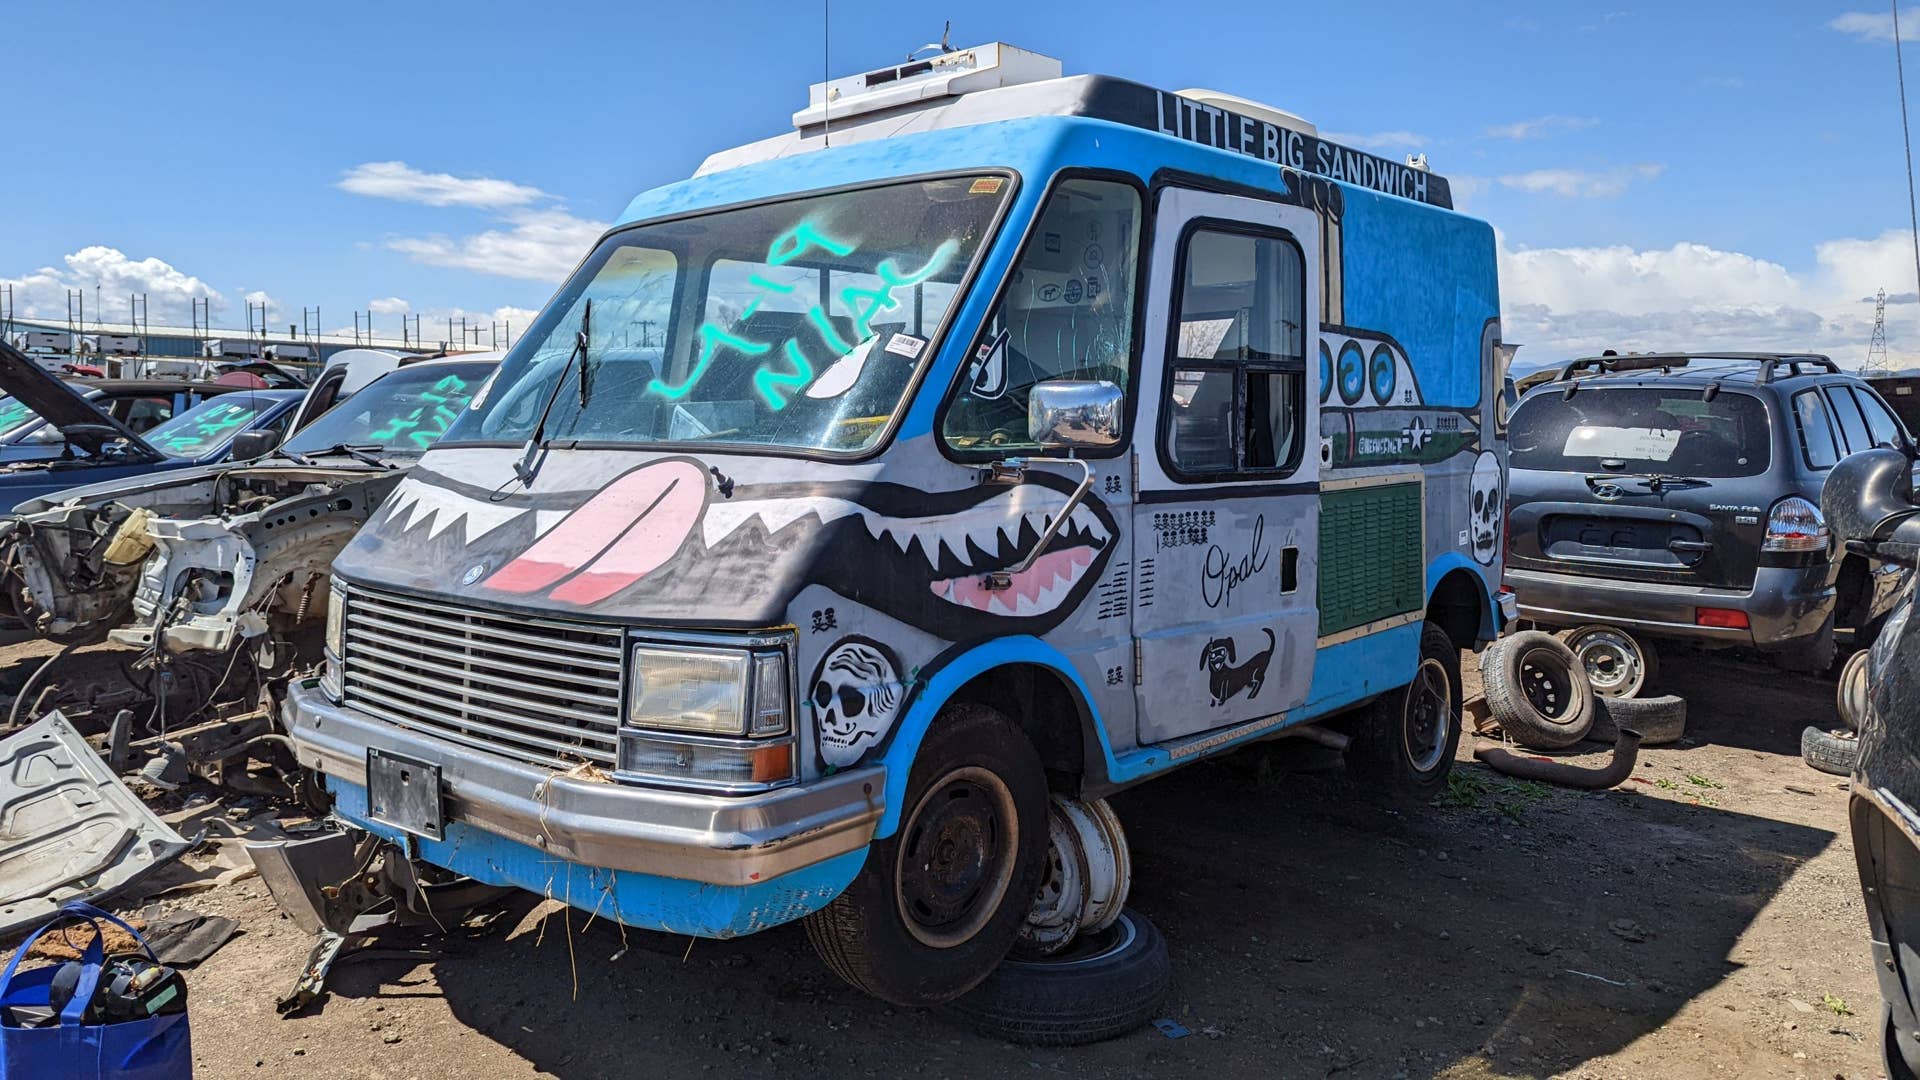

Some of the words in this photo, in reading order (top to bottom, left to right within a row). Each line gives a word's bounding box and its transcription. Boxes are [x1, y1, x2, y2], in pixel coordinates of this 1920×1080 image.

[1156, 91, 1255, 157] LITTLE
[1263, 123, 1304, 170] BIG
[1316, 142, 1428, 202] SANDWICH
[1709, 503, 1739, 512] SANTA
[1202, 513, 1271, 609] Opal
